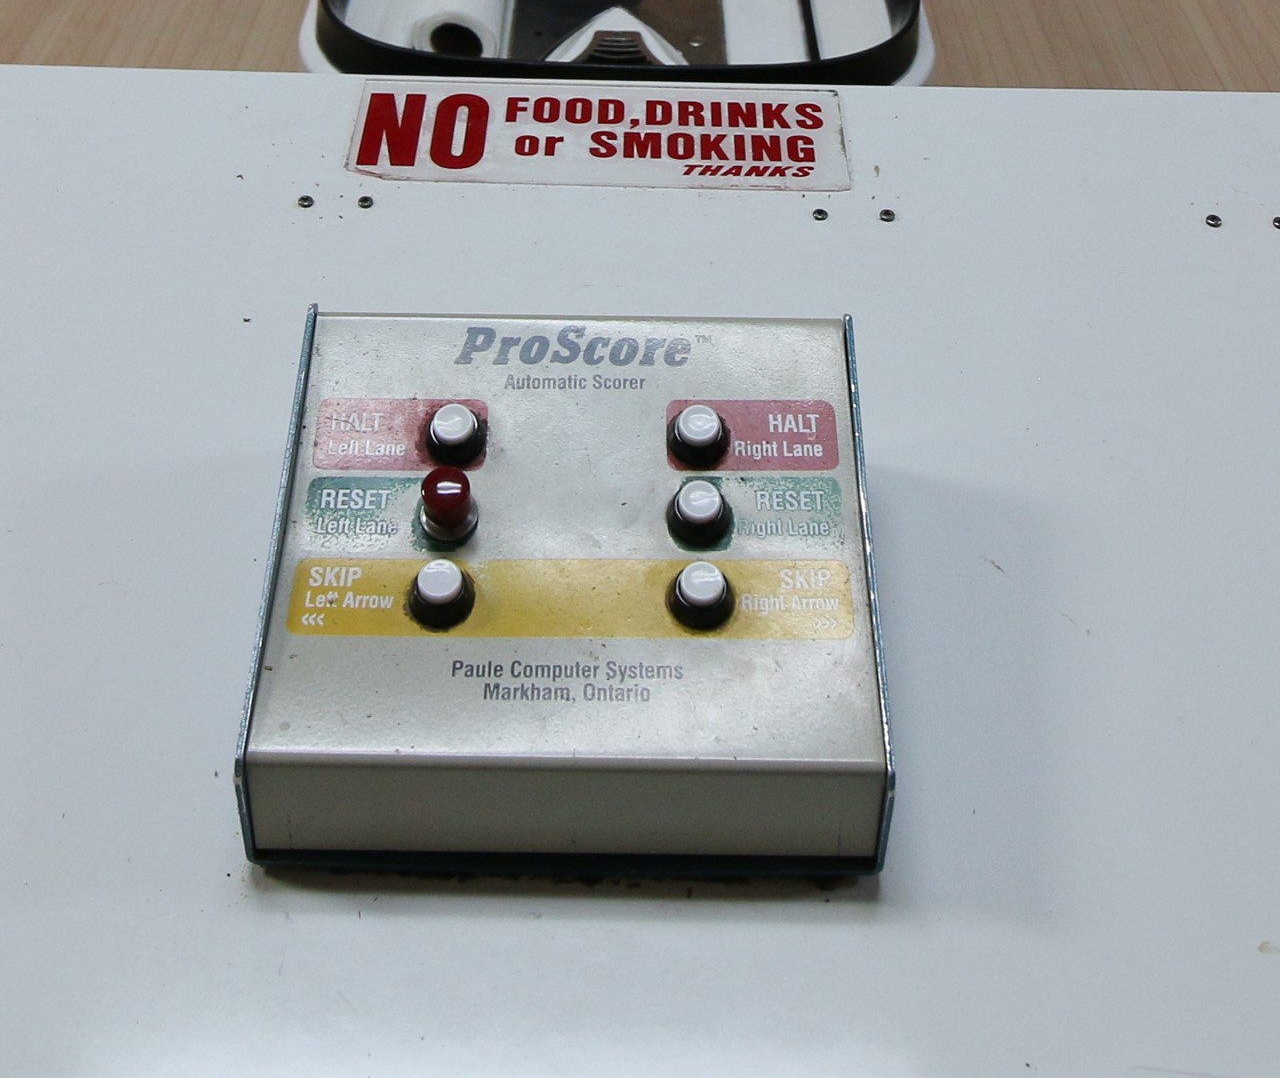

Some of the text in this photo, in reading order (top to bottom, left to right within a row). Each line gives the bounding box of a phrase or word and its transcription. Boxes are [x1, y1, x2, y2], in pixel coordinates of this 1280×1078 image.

[355, 93, 490, 170] NO
[514, 131, 816, 163] or SMOKING
[683, 164, 815, 178] THANKS
[454, 325, 692, 367] ProScore
[504, 374, 646, 390] Automatic Scorer
[331, 412, 384, 432] HALT
[768, 414, 819, 433] HALT
[327, 440, 406, 456] Left Lane
[735, 440, 823, 460] Right Lane
[320, 489, 392, 509] RESET
[756, 491, 824, 510] RESET
[317, 517, 399, 534] Left Lane
[737, 519, 830, 538] Right Lane
[308, 566, 362, 587] SKIP
[779, 569, 831, 589] SKIP
[342, 591, 394, 609] Arrow
[741, 594, 839, 614] Right Arrow
[451, 660, 684, 683] Paule Computer Systems
[483, 682, 651, 703] Markham, Ontario
